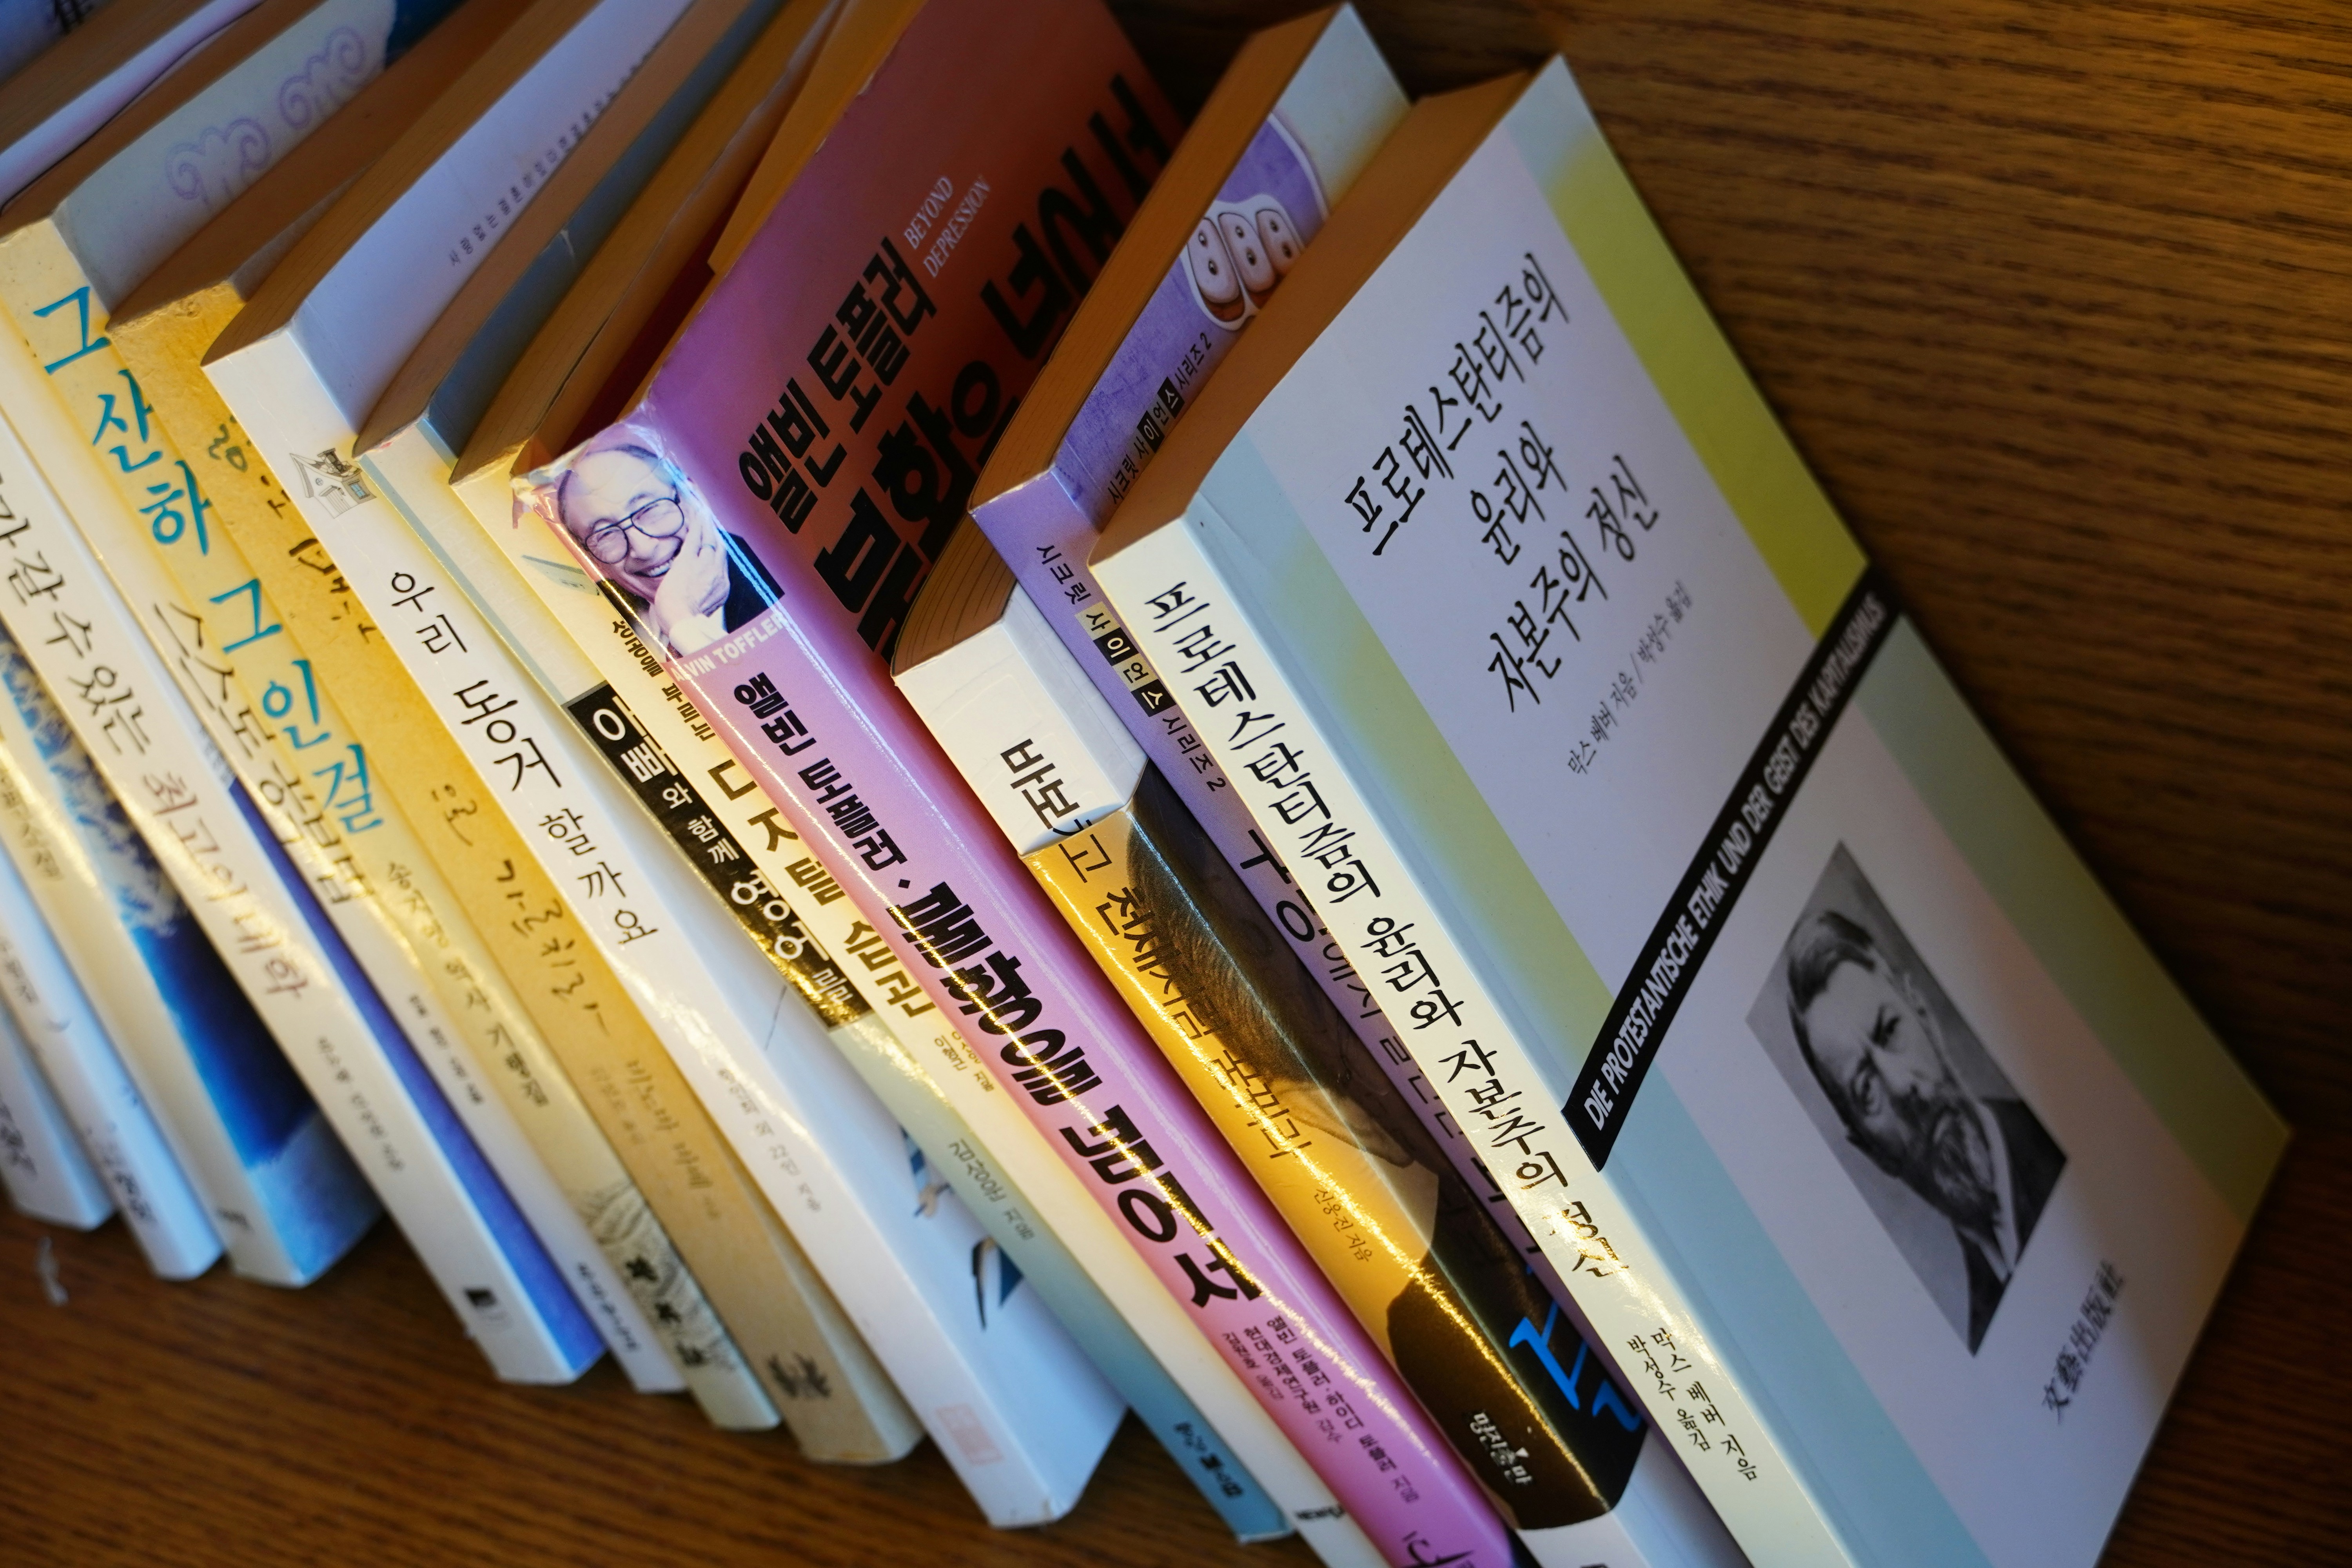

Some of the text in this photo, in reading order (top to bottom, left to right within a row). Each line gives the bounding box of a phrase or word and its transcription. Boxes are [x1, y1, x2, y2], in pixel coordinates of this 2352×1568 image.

[904, 176, 955, 251] BEYOND
[921, 174, 992, 278] DEPRESSION
[739, 237, 939, 535] 앨빈 토플러
[1107, 333, 1212, 505] 시크릿 사이언스 시리즈 2
[1345, 251, 1570, 557] 프로테스탄티즘의
[33, 286, 110, 374] 그
[93, 369, 212, 555] 산하
[210, 578, 283, 655] 그
[262, 660, 385, 836] 인걸
[813, 355, 1023, 659] 불황을
[1468, 419, 1568, 566] 윤리와
[9, 550, 65, 606] 갈
[45, 611, 93, 660] 수
[670, 613, 788, 682] ALVIN TOFFLER
[1488, 455, 1660, 713] 자본주의 정신
[68, 664, 152, 756] 있는
[661, 682, 715, 743] 부르는
[1035, 543, 1227, 793] 시크릿 사이언스 시리즈 2
[1568, 739, 1597, 776] 막스
[1588, 700, 1621, 743] 베버
[1607, 668, 1639, 708] 지음
[154, 601, 276, 760] 스스로
[258, 760, 377, 907] 공부법
[390, 570, 468, 655] 우리
[453, 678, 563, 792] 동거
[537, 808, 661, 947] 할까요
[592, 696, 694, 809] 아빠와
[688, 813, 741, 864] 함께
[141, 771, 249, 902] 최고의
[1583, 591, 1884, 1131] DIE PROTESTANTISCHE ETHIK UND DER GEIST DES KAPITALISMUS
[232, 906, 310, 1007] 대학
[733, 670, 817, 759] 앨빈
[796, 757, 909, 872] 토플러
[885, 881, 1103, 1105] 불황을
[1059, 1104, 1262, 1308] 넘어서
[843, 920, 937, 1018] 습관
[1095, 887, 1218, 1041] 천재처럼
[1143, 580, 1384, 904] 프로테스탄티즘의
[1360, 915, 1466, 1031] 윤리와
[1437, 1039, 1572, 1192] 자본주의
[1541, 1200, 1631, 1278] 정신
[1313, 1188, 1374, 1264] 신웅진 지음
[1625, 1333, 1713, 1454] 박성수 옮김
[1648, 1327, 1760, 1482] 막스 베버 지음
